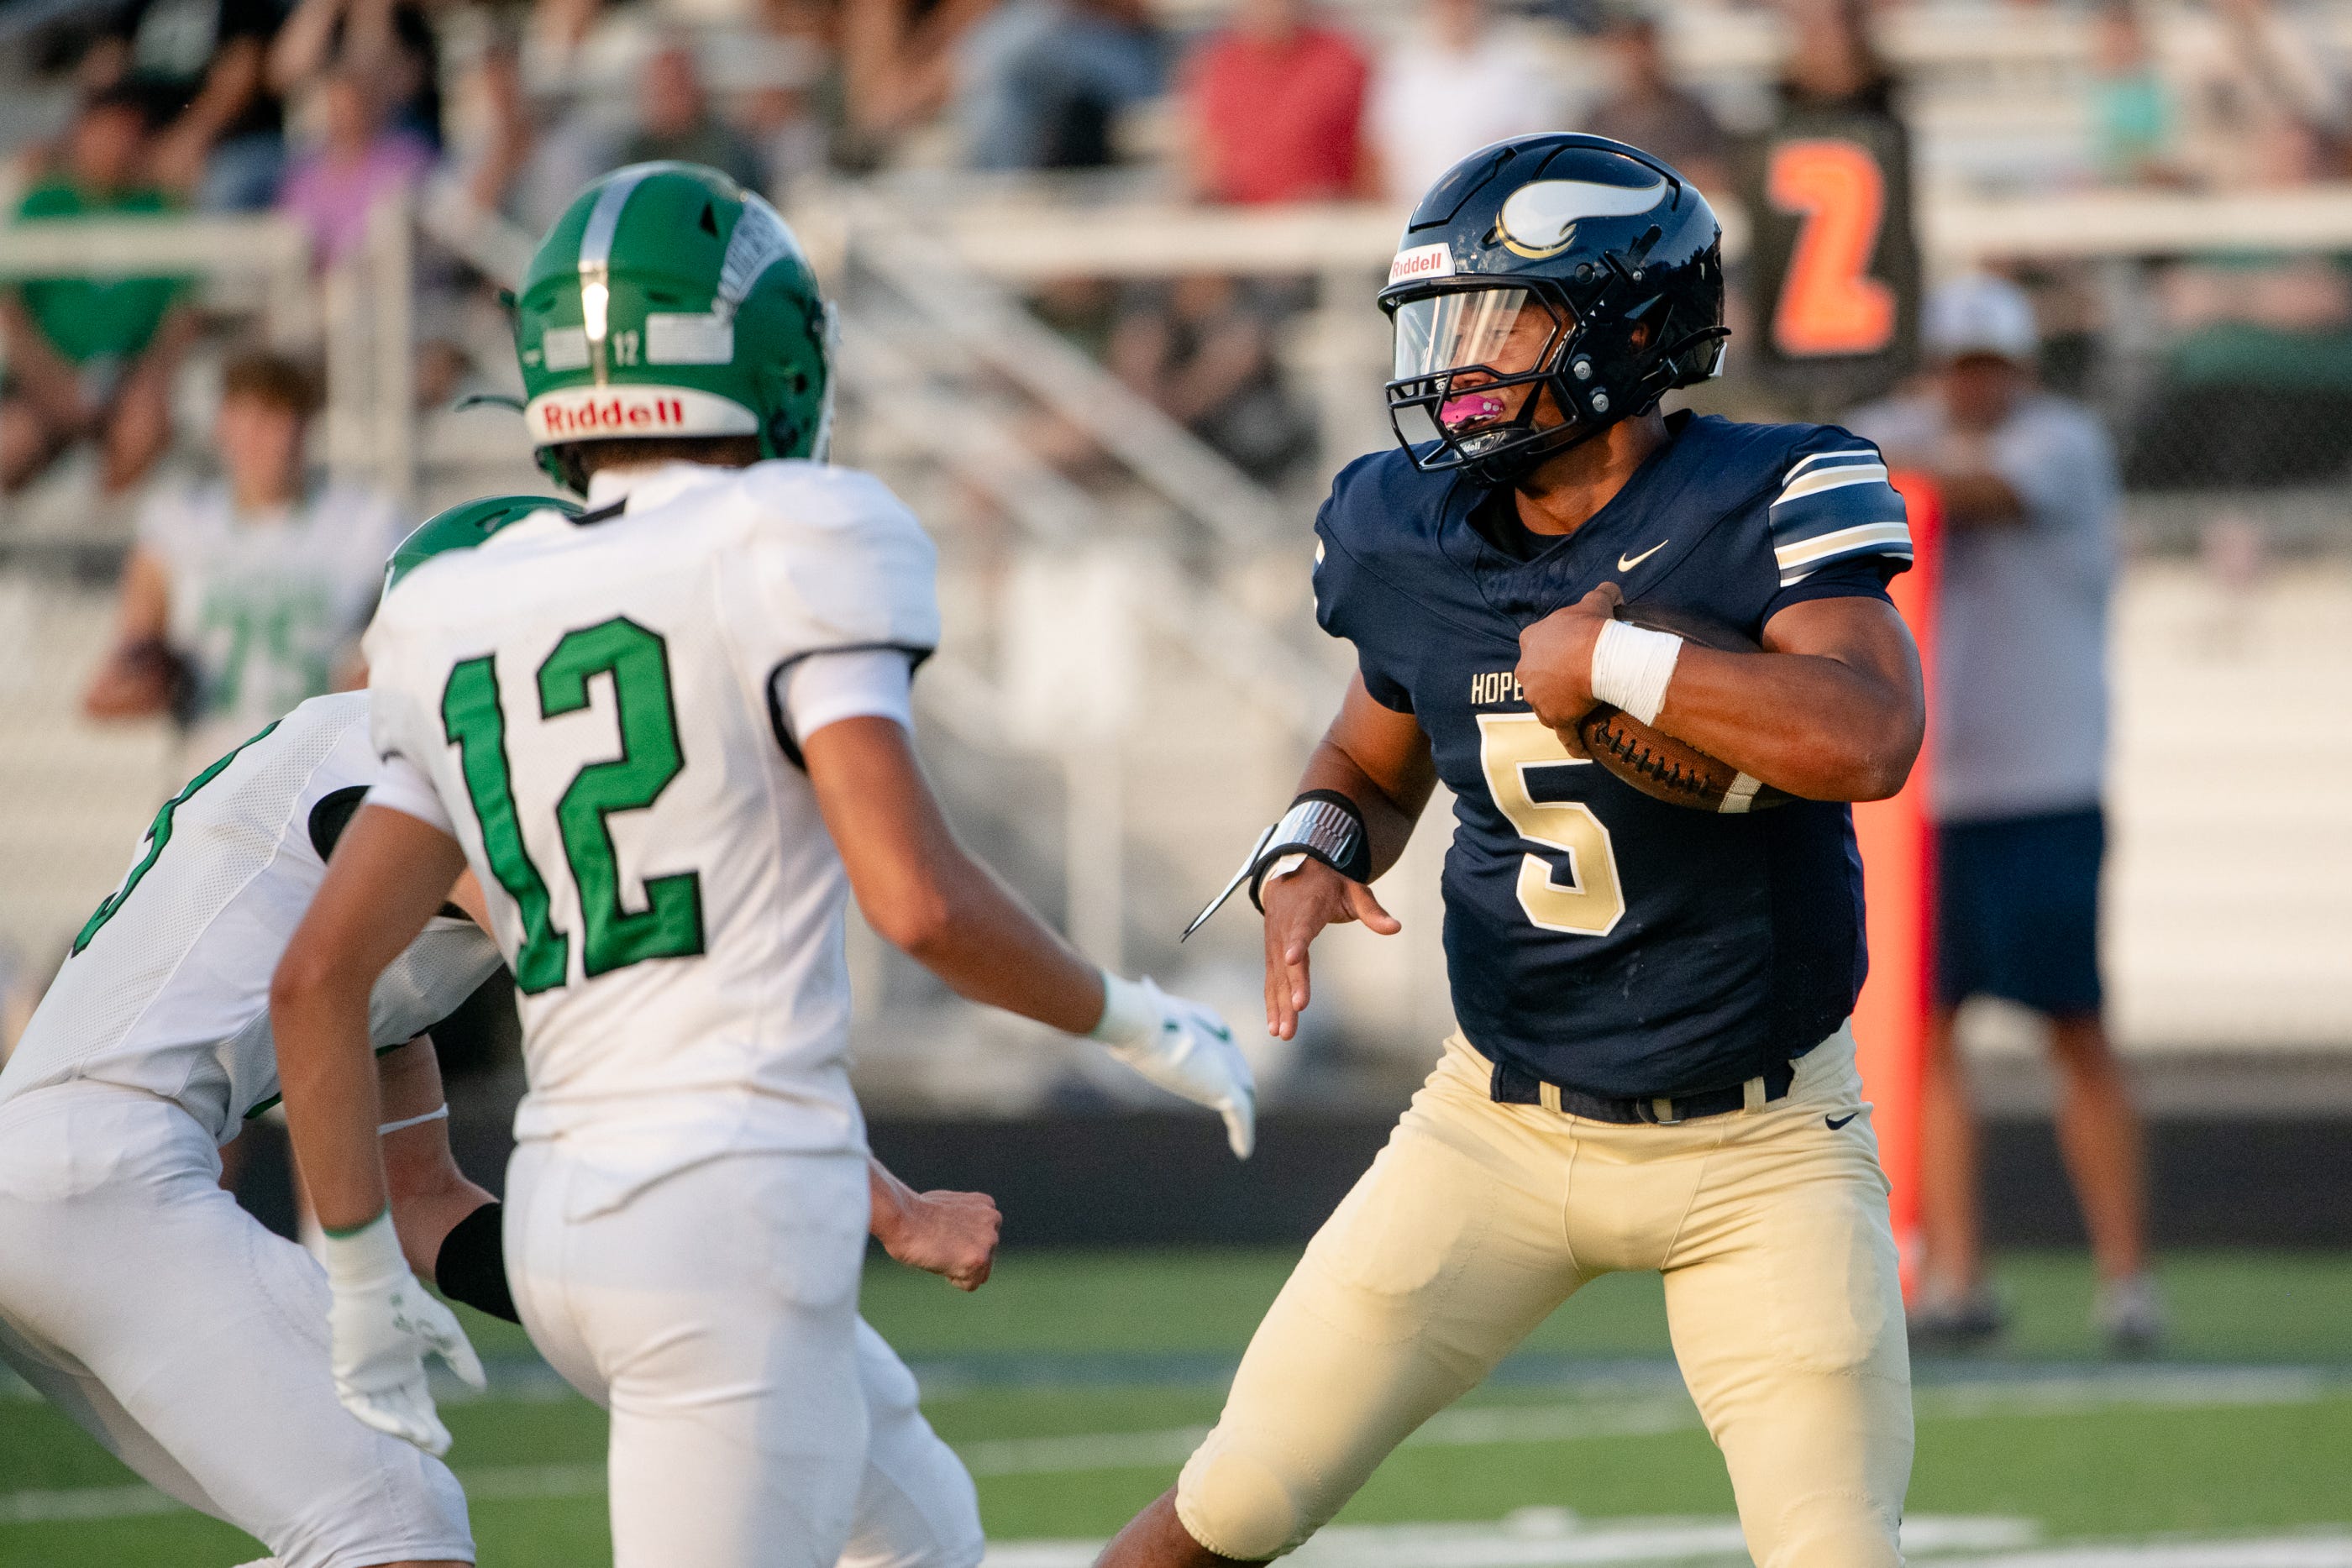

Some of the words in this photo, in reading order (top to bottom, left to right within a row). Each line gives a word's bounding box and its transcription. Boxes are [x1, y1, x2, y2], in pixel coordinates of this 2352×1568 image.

[1392, 253, 1441, 279] Riddell
[1770, 141, 1894, 353] 2
[614, 329, 638, 367] 12
[543, 397, 684, 433] Riddell
[441, 614, 705, 996] 12
[1475, 712, 1626, 936] 5
